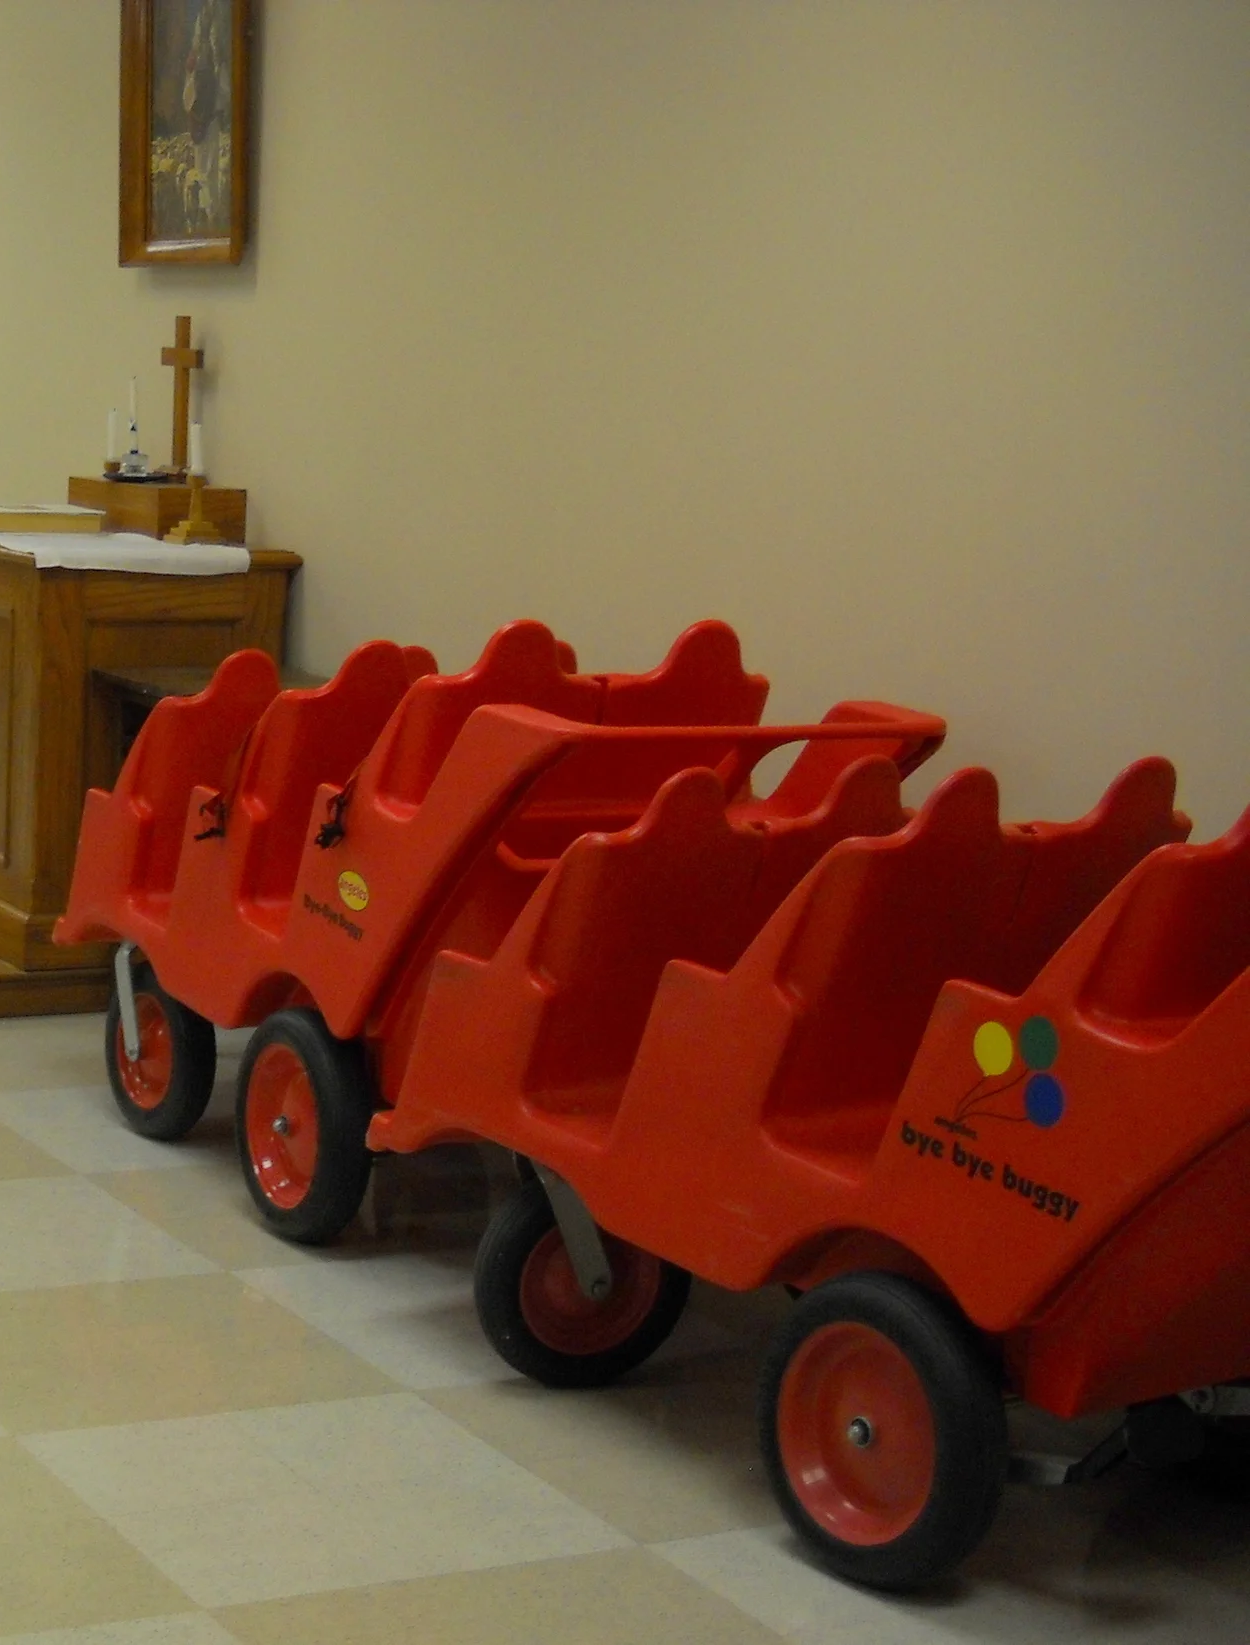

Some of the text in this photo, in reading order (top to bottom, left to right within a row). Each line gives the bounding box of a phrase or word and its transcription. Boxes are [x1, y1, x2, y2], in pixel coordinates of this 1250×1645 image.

[901, 1119, 945, 1160] bye
[951, 1140, 995, 1181] bye
[1001, 1163, 1080, 1223] buggy
